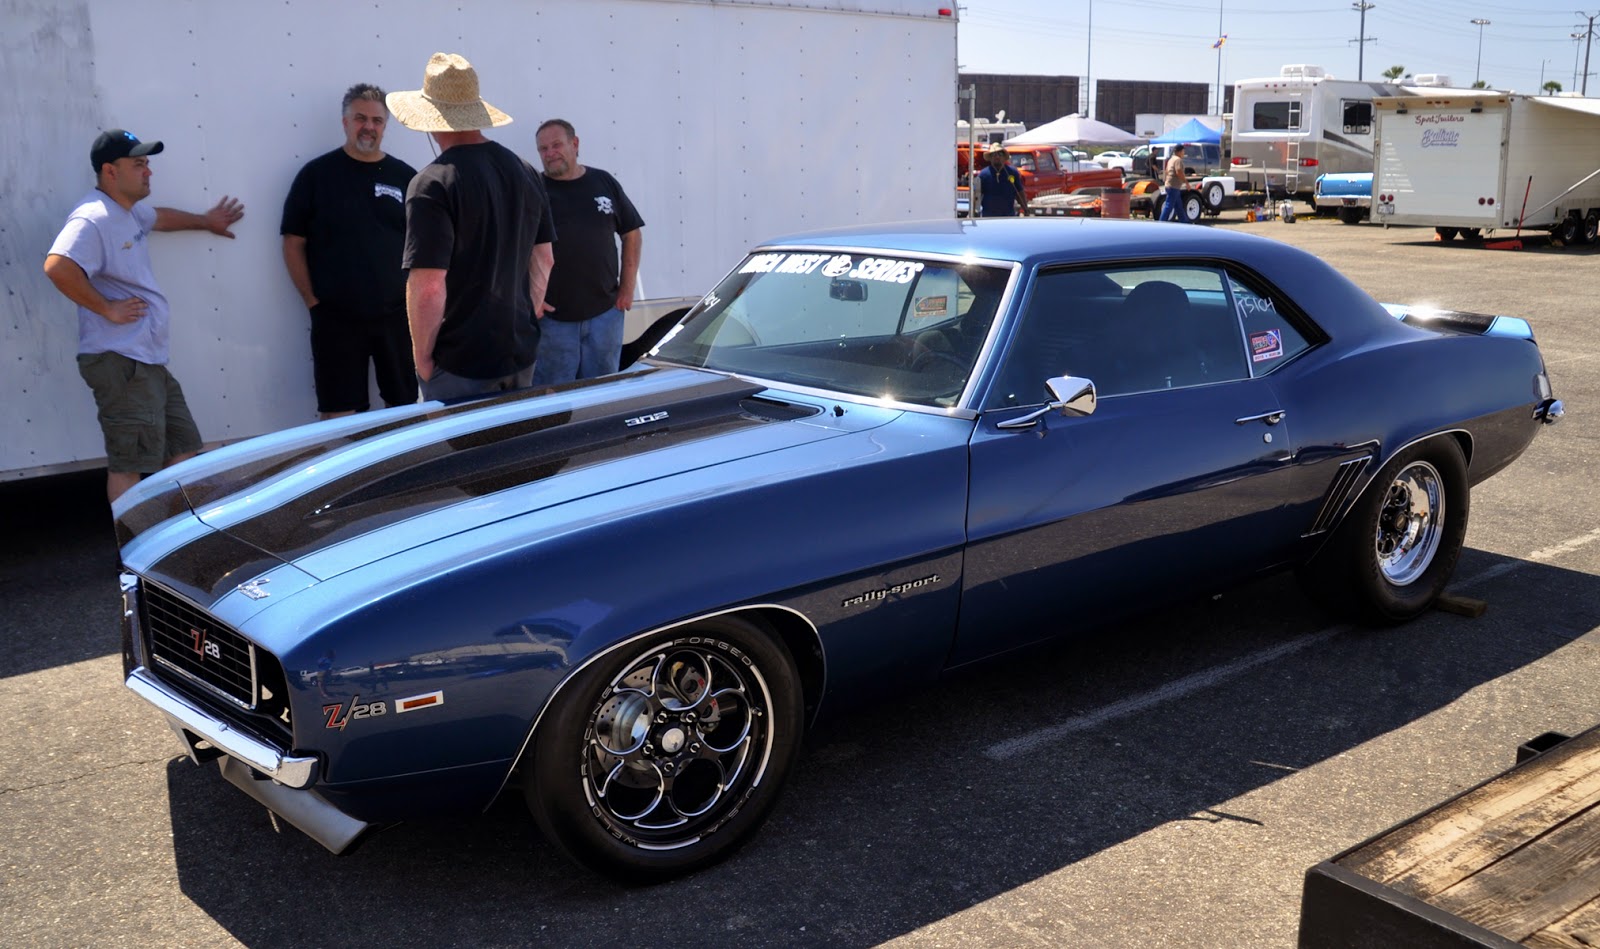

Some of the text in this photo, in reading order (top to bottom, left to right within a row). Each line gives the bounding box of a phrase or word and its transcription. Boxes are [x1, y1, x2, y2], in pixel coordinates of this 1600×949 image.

[850, 257, 924, 284] SERIES
[624, 410, 670, 427] 302
[190, 628, 221, 661] Z/28
[673, 636, 752, 666] FORGED
[322, 695, 387, 732] Z/28
[580, 686, 612, 777] RACING
[592, 804, 638, 848] WELD
